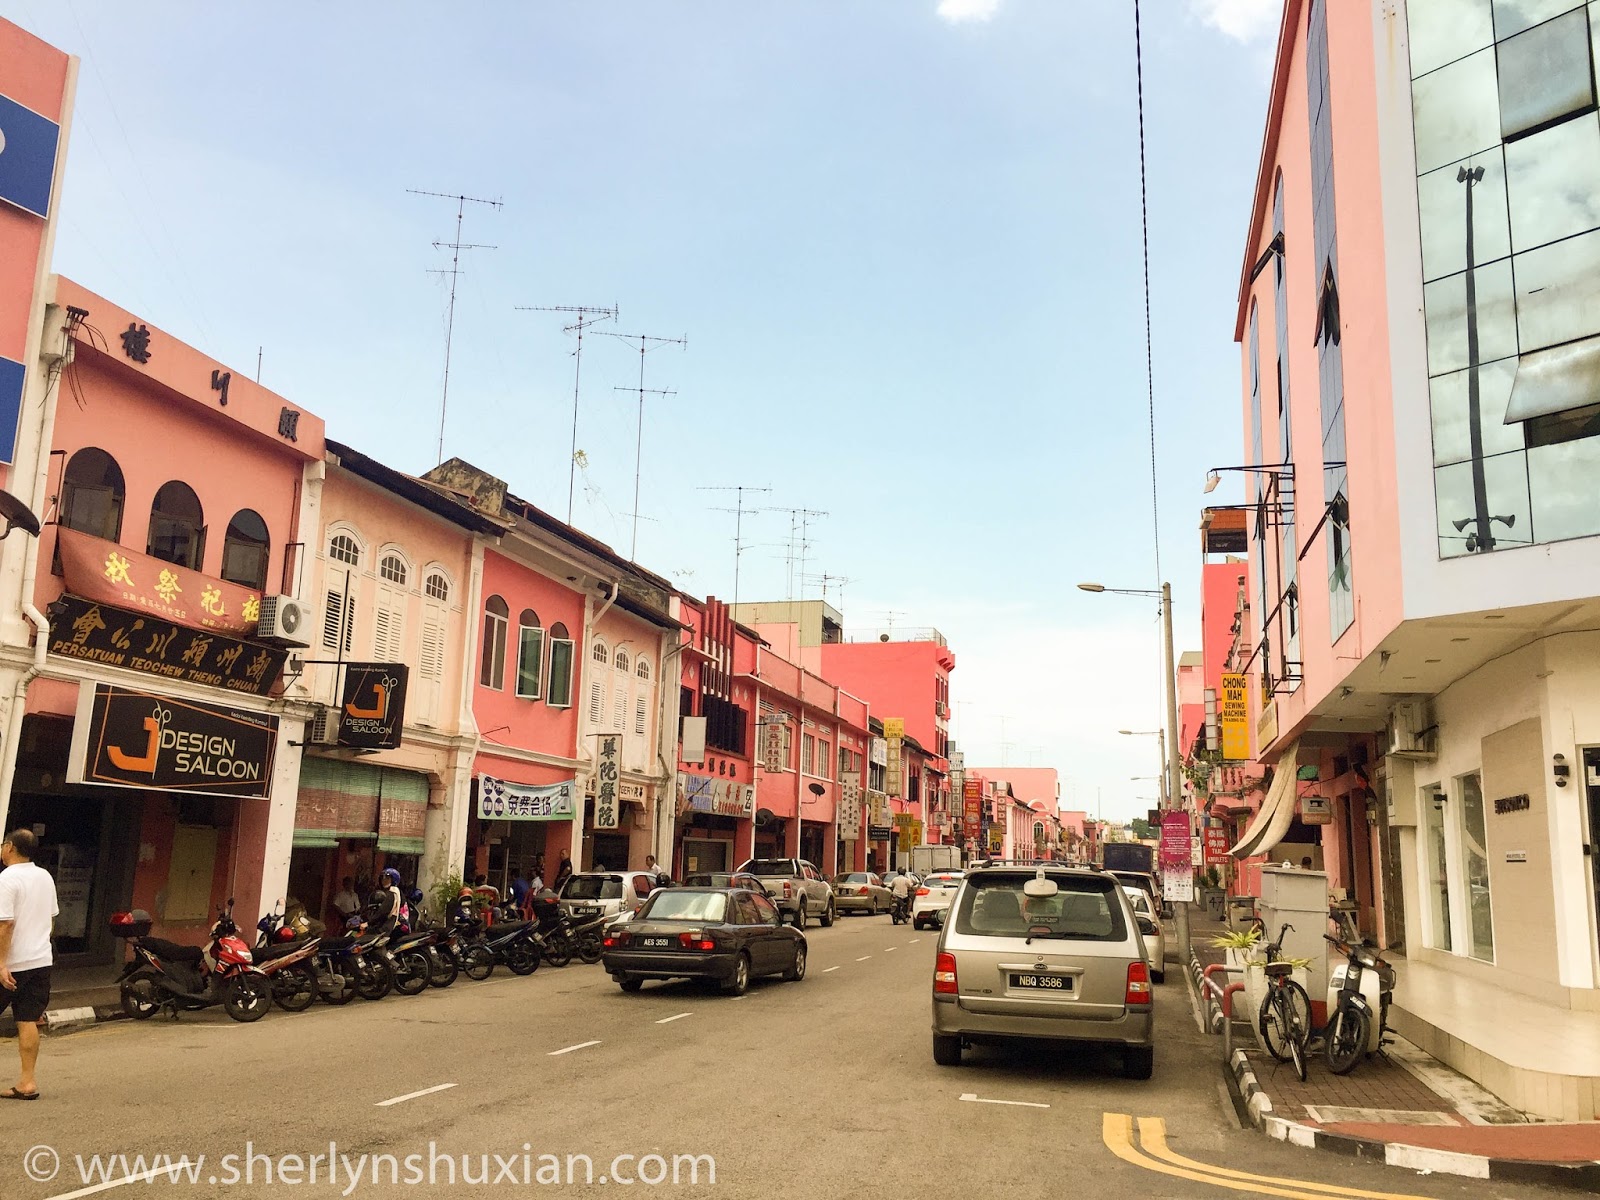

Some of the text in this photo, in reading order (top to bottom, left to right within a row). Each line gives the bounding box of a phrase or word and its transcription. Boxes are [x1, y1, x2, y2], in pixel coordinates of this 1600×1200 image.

[52, 640, 260, 694] PERSATUAN TEOCHEW THENG CHUAN
[1222, 677, 1246, 689] CHONG
[1227, 690, 1243, 700] MAH
[345, 718, 380, 727] DESIGN
[352, 726, 392, 734] SALOON
[160, 729, 236, 757] DESIGN
[175, 753, 259, 780] SALOON
[643, 938, 655, 946] AES
[1019, 975, 1063, 988] NBQ 3586
